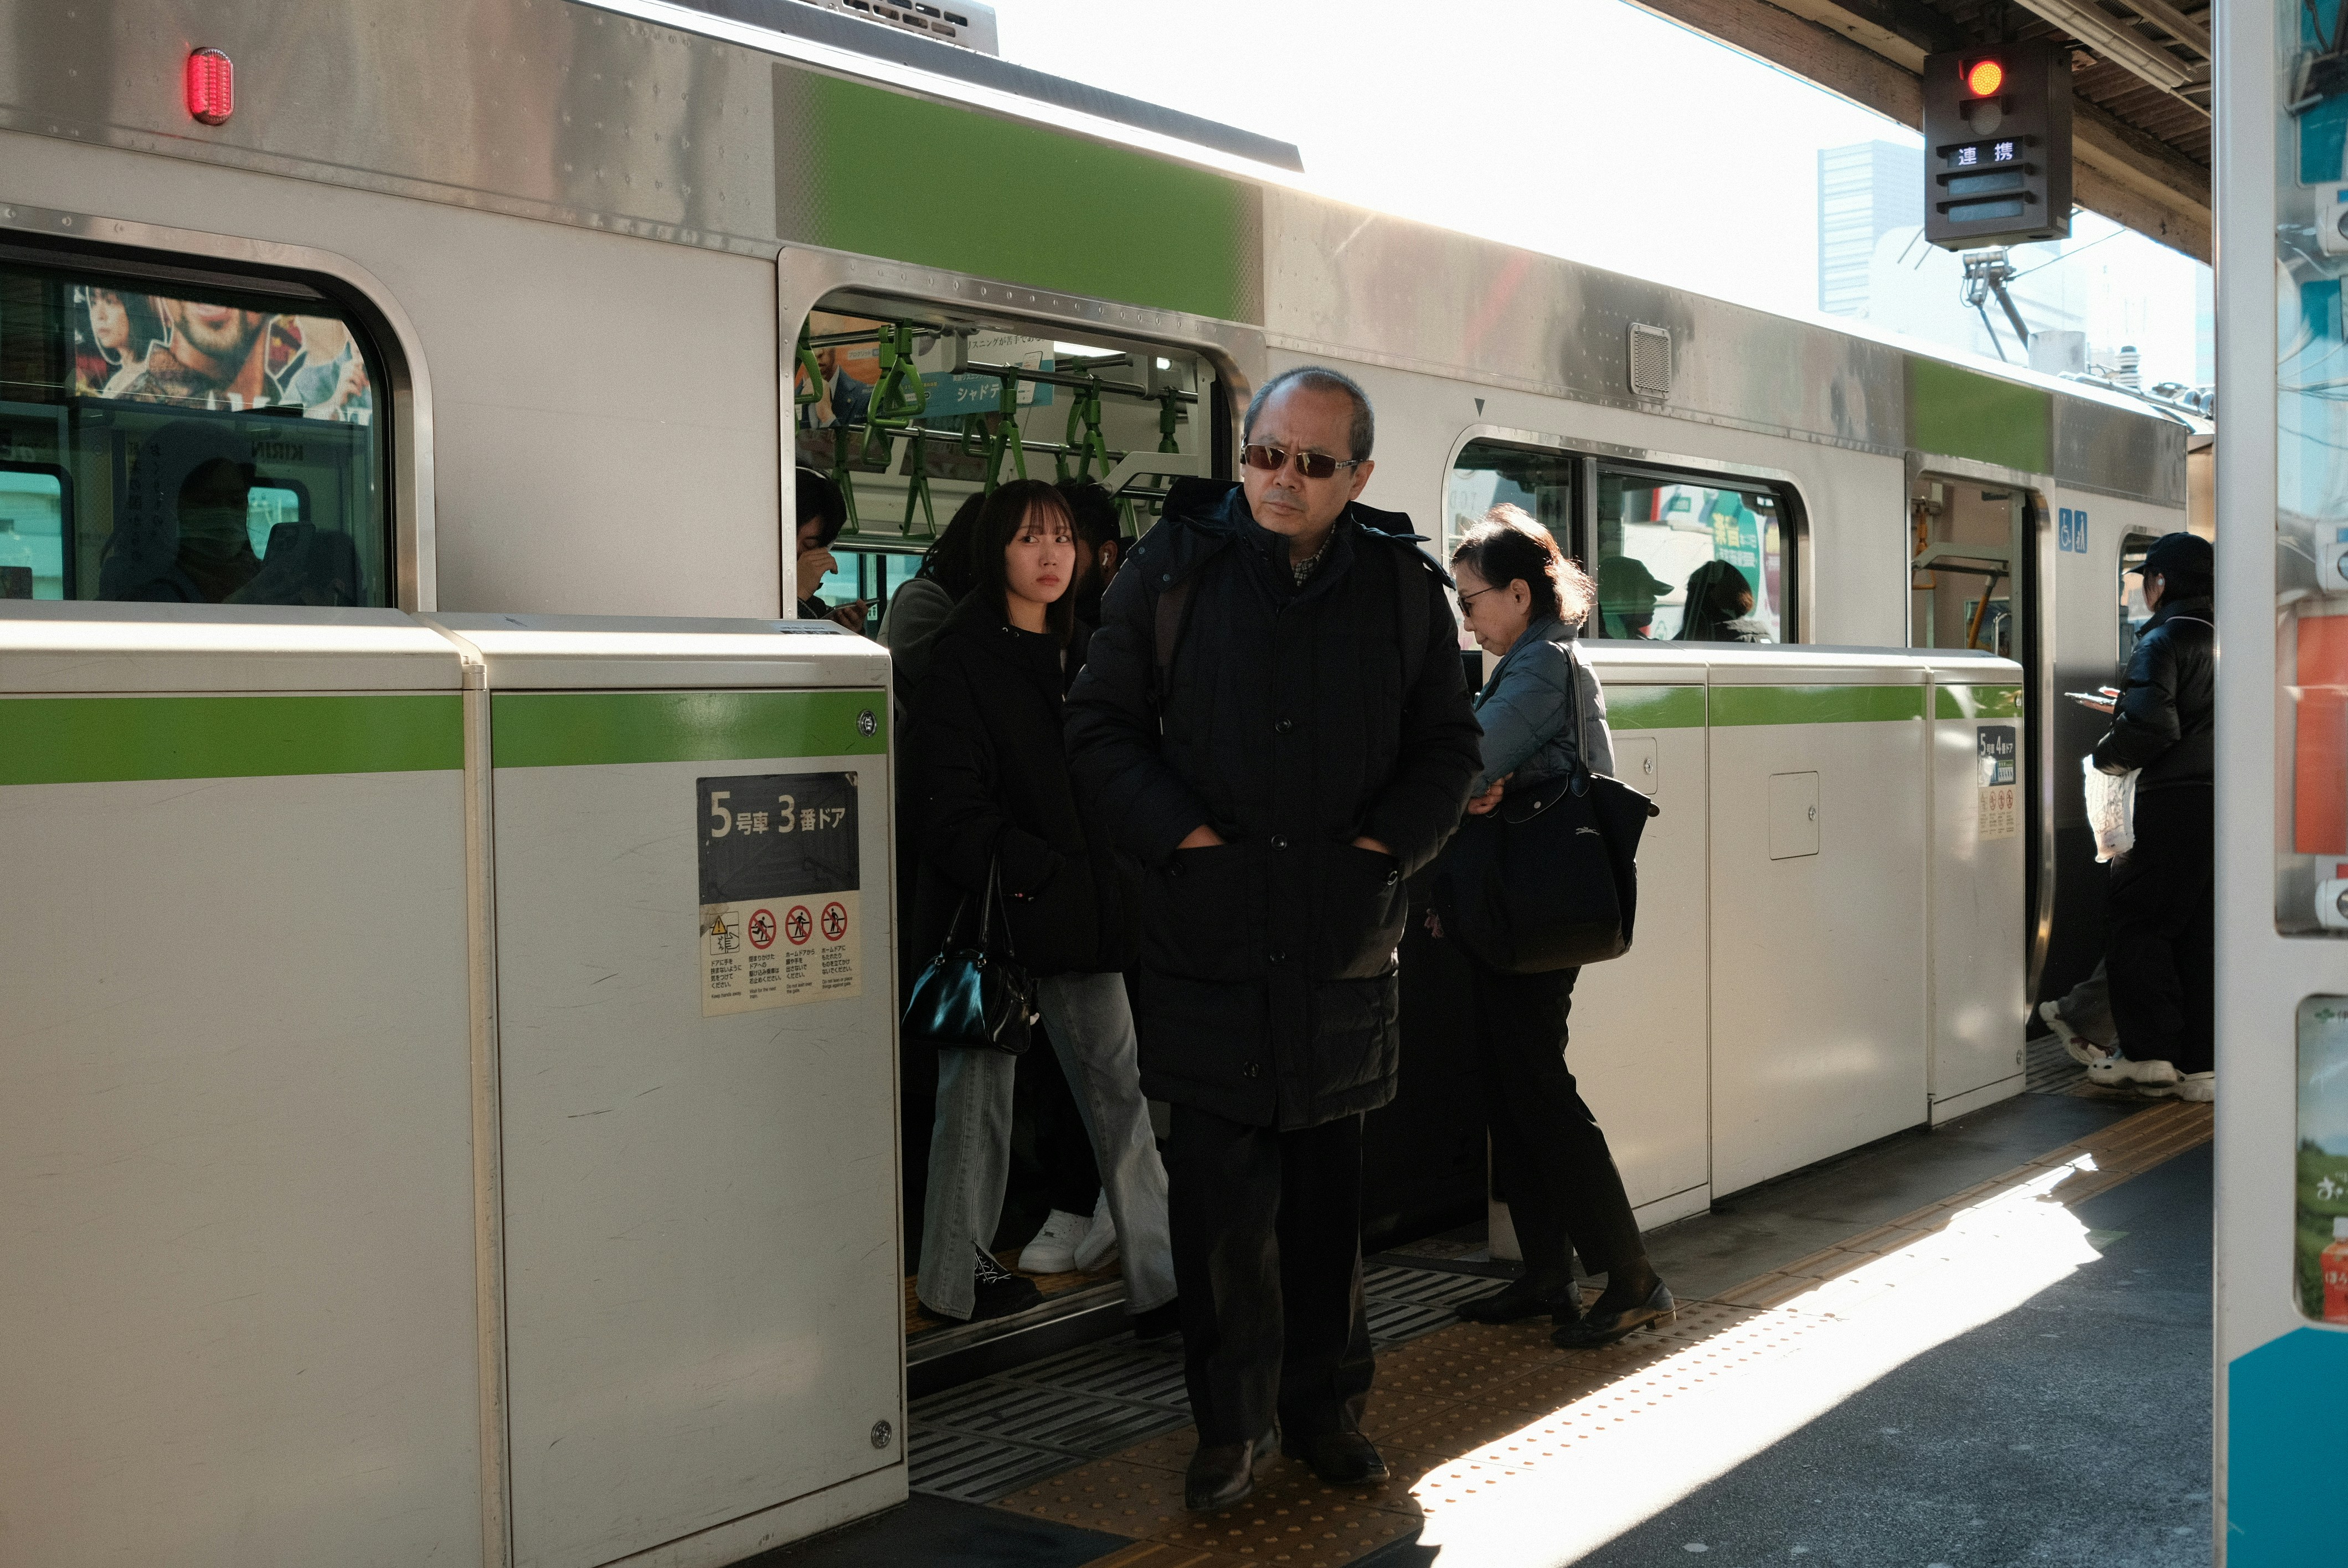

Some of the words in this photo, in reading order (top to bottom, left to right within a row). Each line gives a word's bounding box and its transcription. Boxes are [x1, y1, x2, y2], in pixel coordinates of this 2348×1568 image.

[711, 791, 769, 838] 5号車
[778, 795, 846, 834] 3番ドア
[786, 948, 815, 957] ホームドアから
[822, 945, 846, 953] ホームドアに
[822, 952, 842, 961] もたれたり
[711, 958, 733, 967] ドアに手を
[822, 958, 850, 967] ものを立てかけ
[786, 964, 807, 972] 出さないで
[711, 973, 733, 982] 気をつけて
